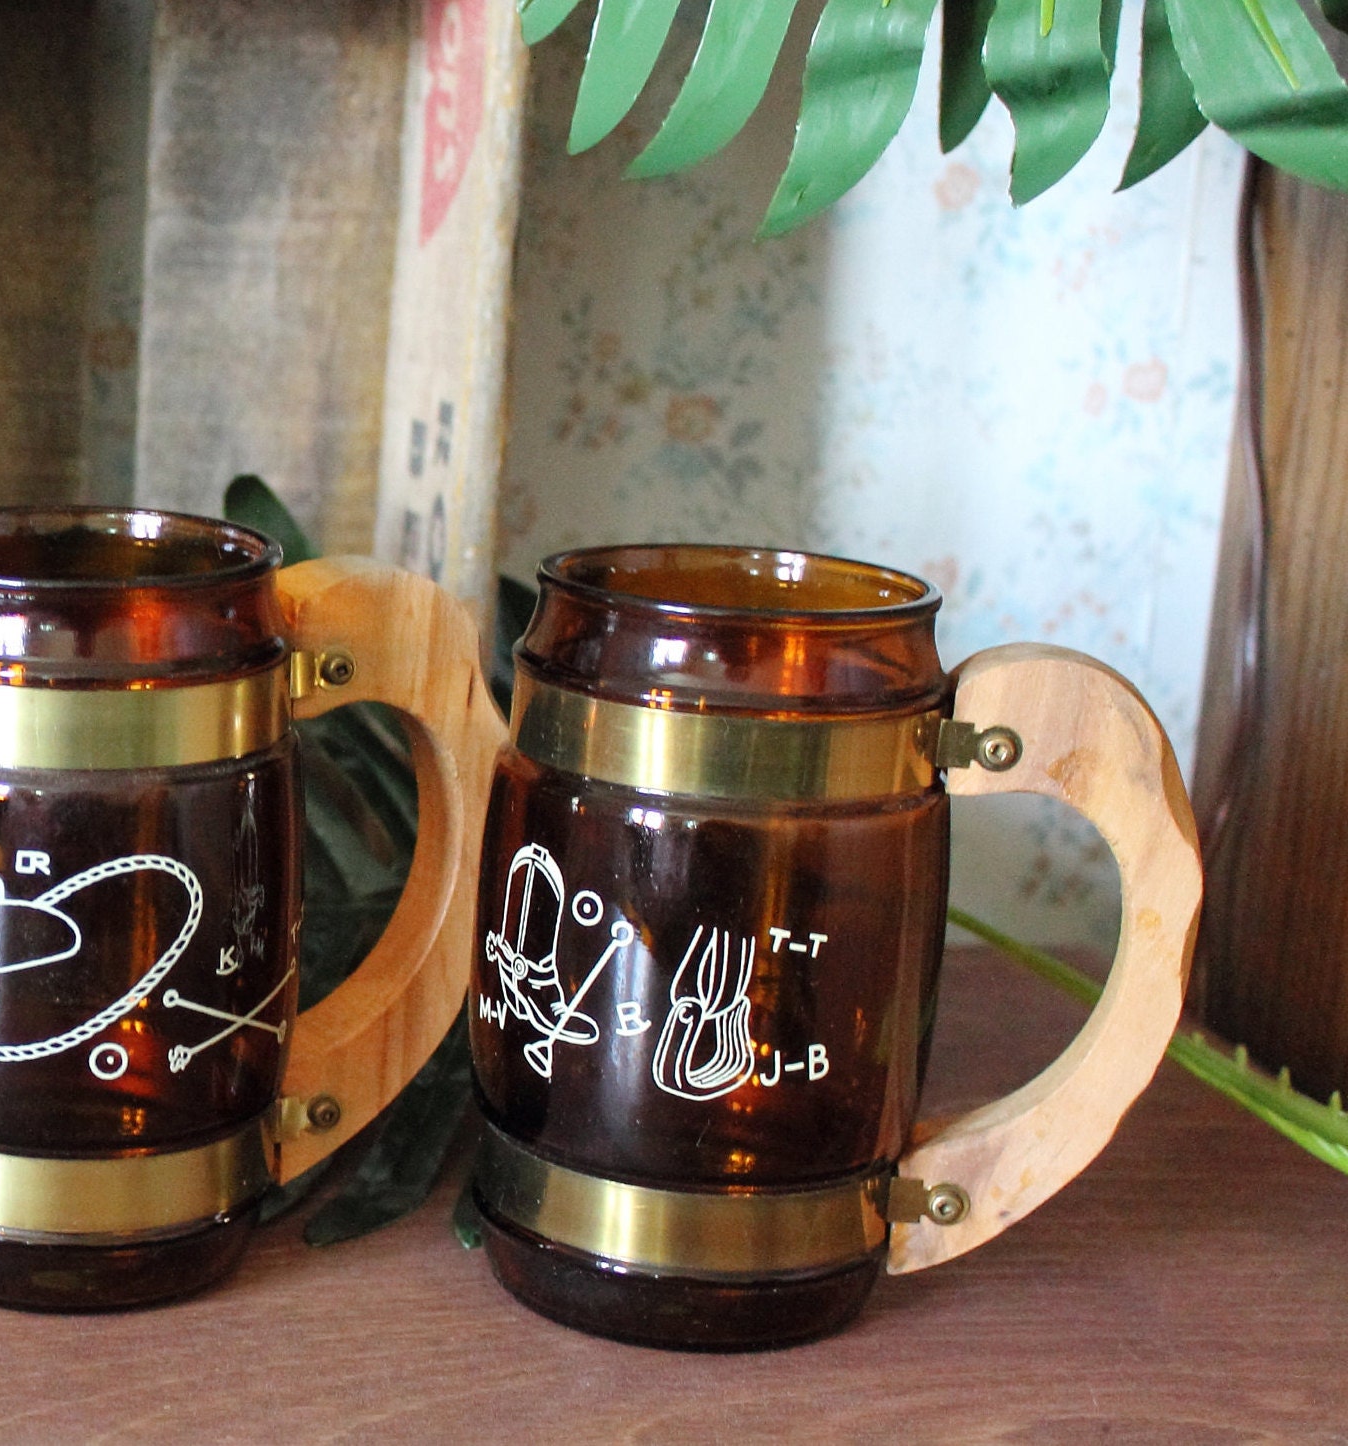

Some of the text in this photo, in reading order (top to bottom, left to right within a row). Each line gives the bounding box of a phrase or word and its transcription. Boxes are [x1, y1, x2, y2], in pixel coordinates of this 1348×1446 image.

[769, 927, 828, 959] T-T
[479, 993, 507, 1029] M-V
[759, 1043, 830, 1087] J-B
